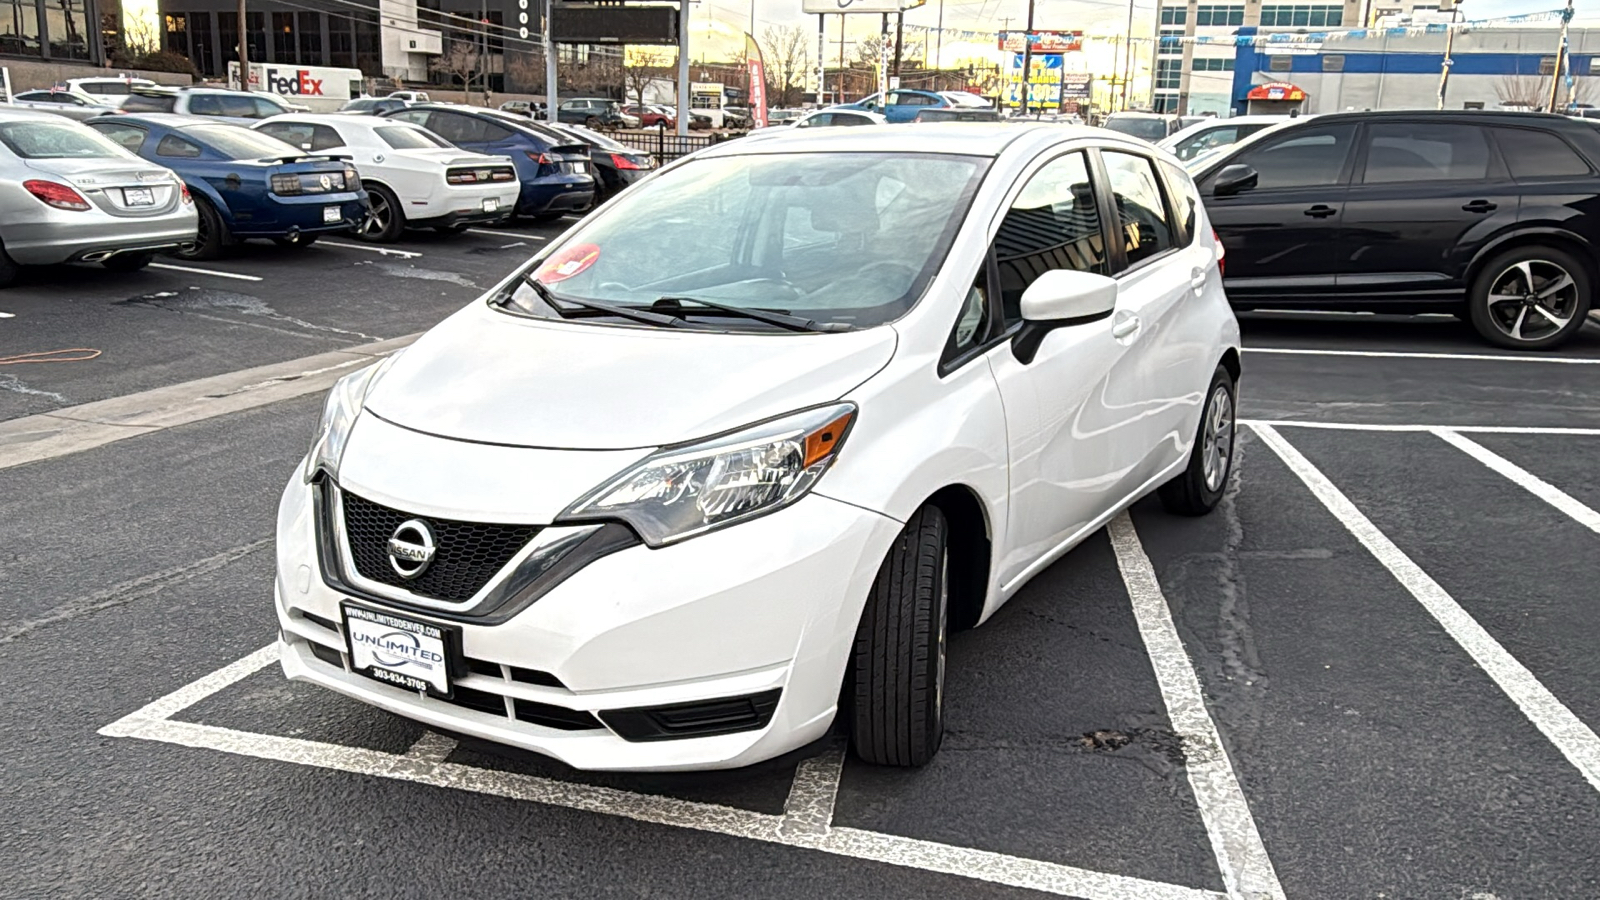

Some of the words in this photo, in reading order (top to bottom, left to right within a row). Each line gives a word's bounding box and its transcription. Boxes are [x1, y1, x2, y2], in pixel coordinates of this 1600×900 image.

[232, 70, 260, 84] FEx
[267, 68, 323, 95] FedEx
[390, 545, 426, 559] NISSAN
[353, 631, 443, 662] UNLIMITED
[373, 668, 427, 691] 303-934-3705
